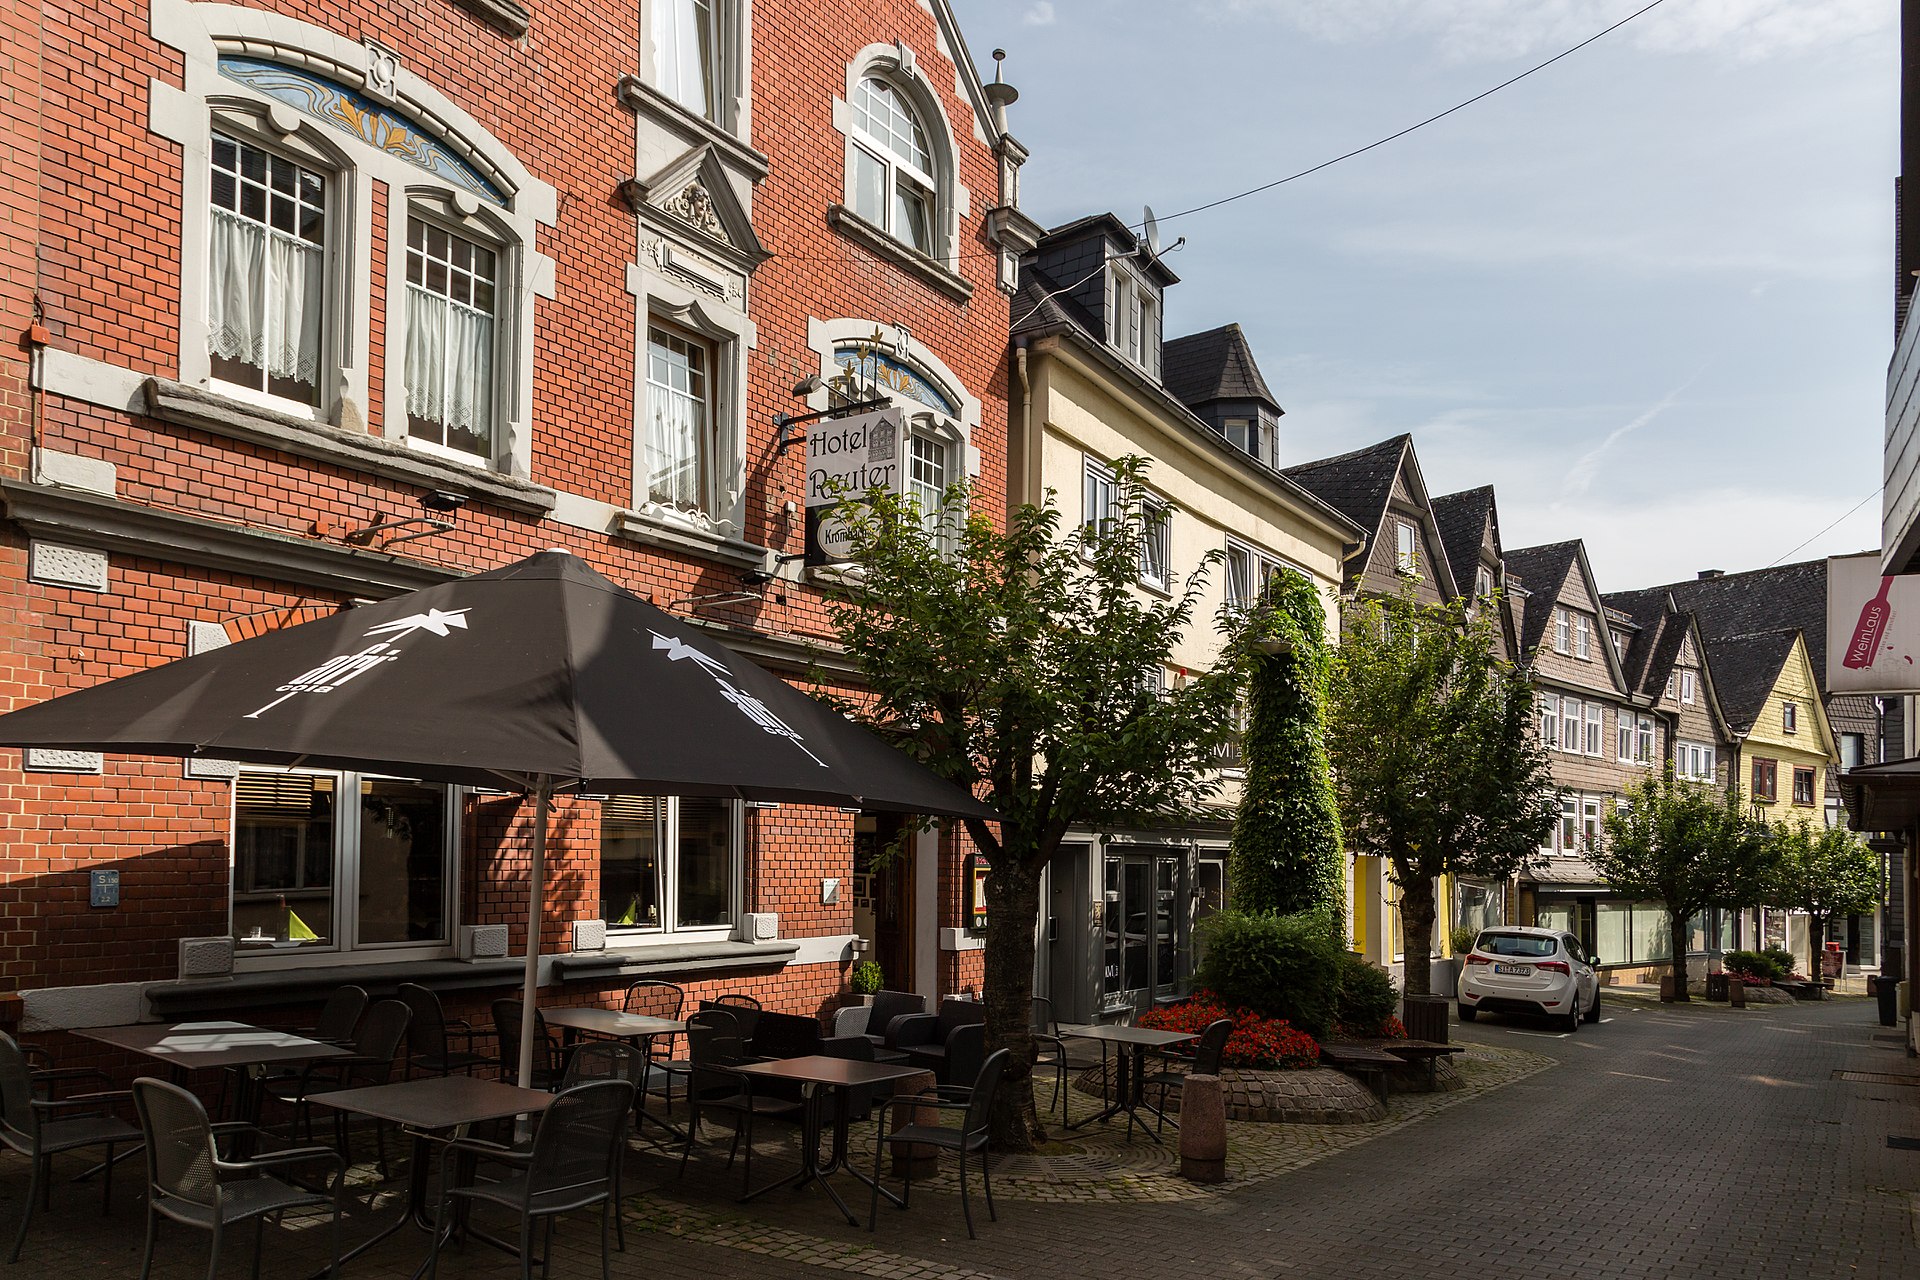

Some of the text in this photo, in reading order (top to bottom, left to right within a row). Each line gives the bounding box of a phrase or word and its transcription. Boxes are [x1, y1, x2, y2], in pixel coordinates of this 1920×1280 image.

[809, 423, 867, 458] Hotel
[809, 463, 896, 499] Reuter
[1850, 606, 1882, 661] WeinLaus
[275, 684, 335, 694] cola
[98, 875, 106, 884] S
